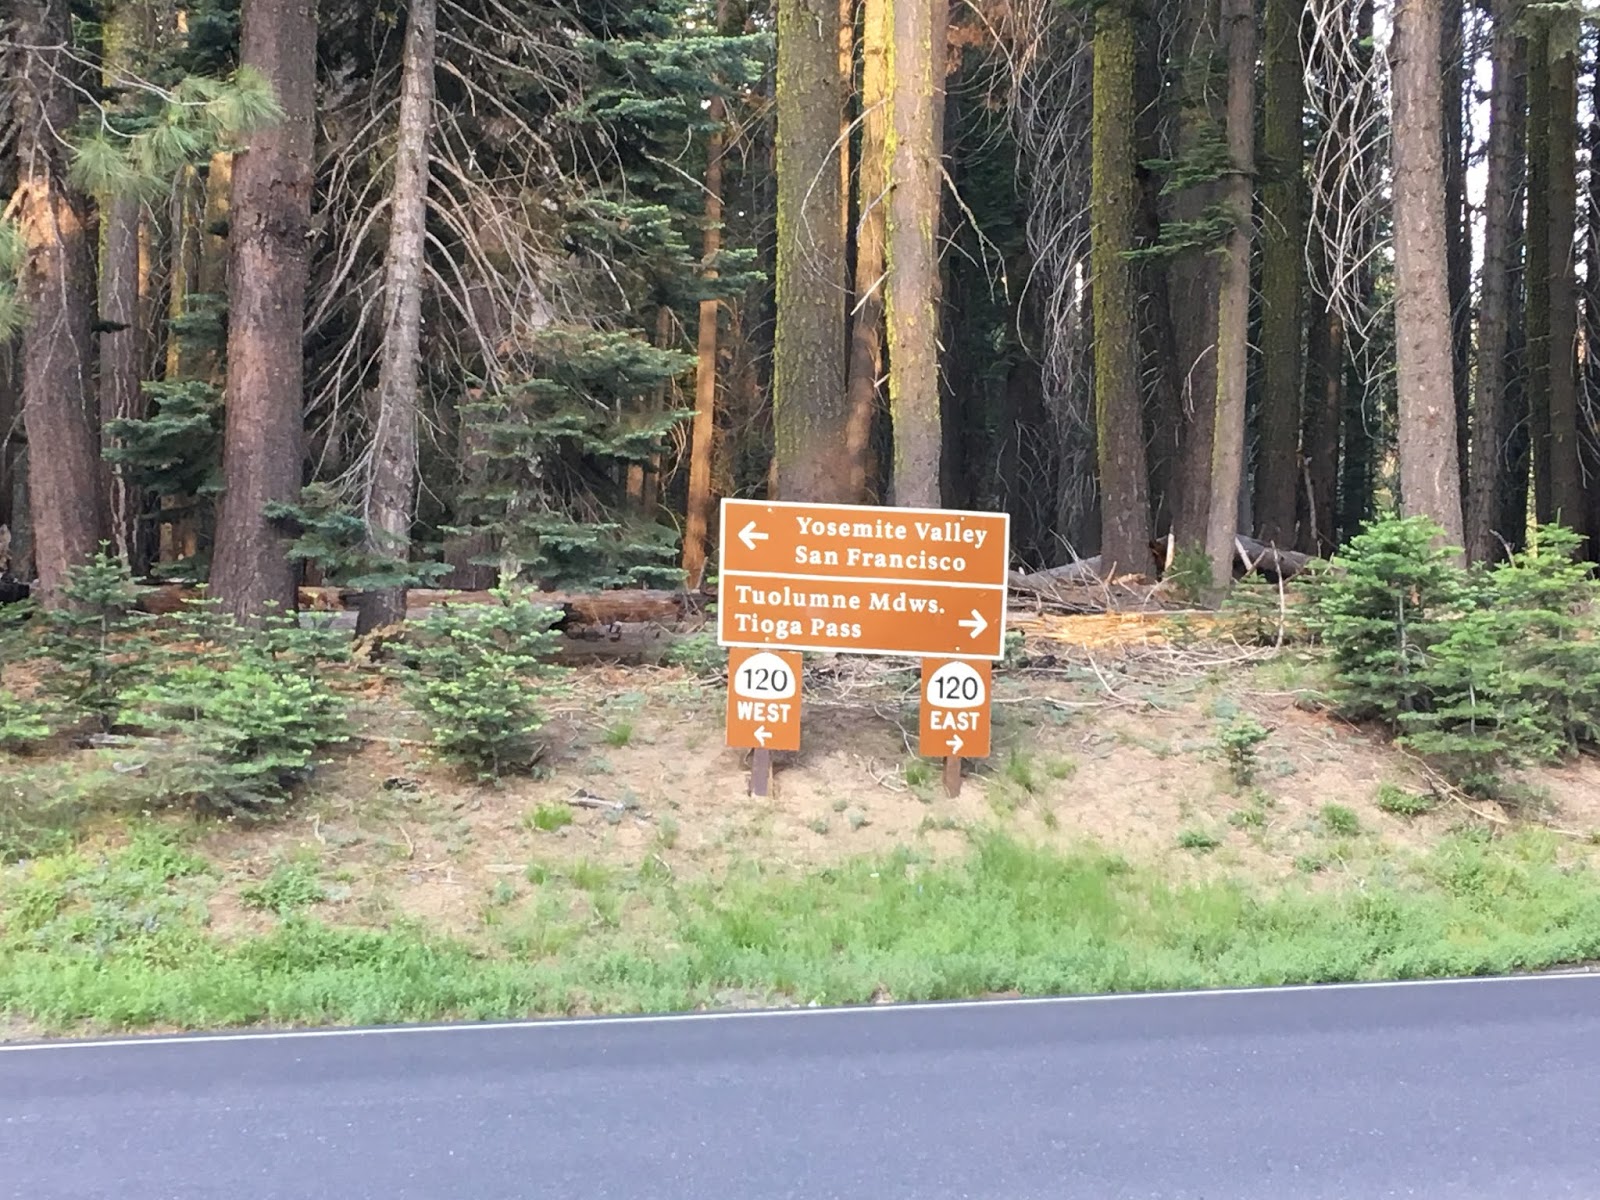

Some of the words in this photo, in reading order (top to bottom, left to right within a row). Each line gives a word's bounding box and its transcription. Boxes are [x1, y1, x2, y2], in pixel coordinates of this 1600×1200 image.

[796, 516, 907, 539] Yosemite
[915, 522, 987, 549] Valley
[795, 546, 838, 565] San
[847, 548, 966, 571] Francisco
[735, 585, 860, 610] Tuolumne
[868, 592, 945, 614] Mdws.
[734, 613, 803, 639] Tioga
[810, 618, 862, 638] Pass
[743, 668, 788, 692] 120
[935, 676, 978, 700] 120
[737, 701, 791, 723] WEST
[930, 711, 980, 731] EAST
